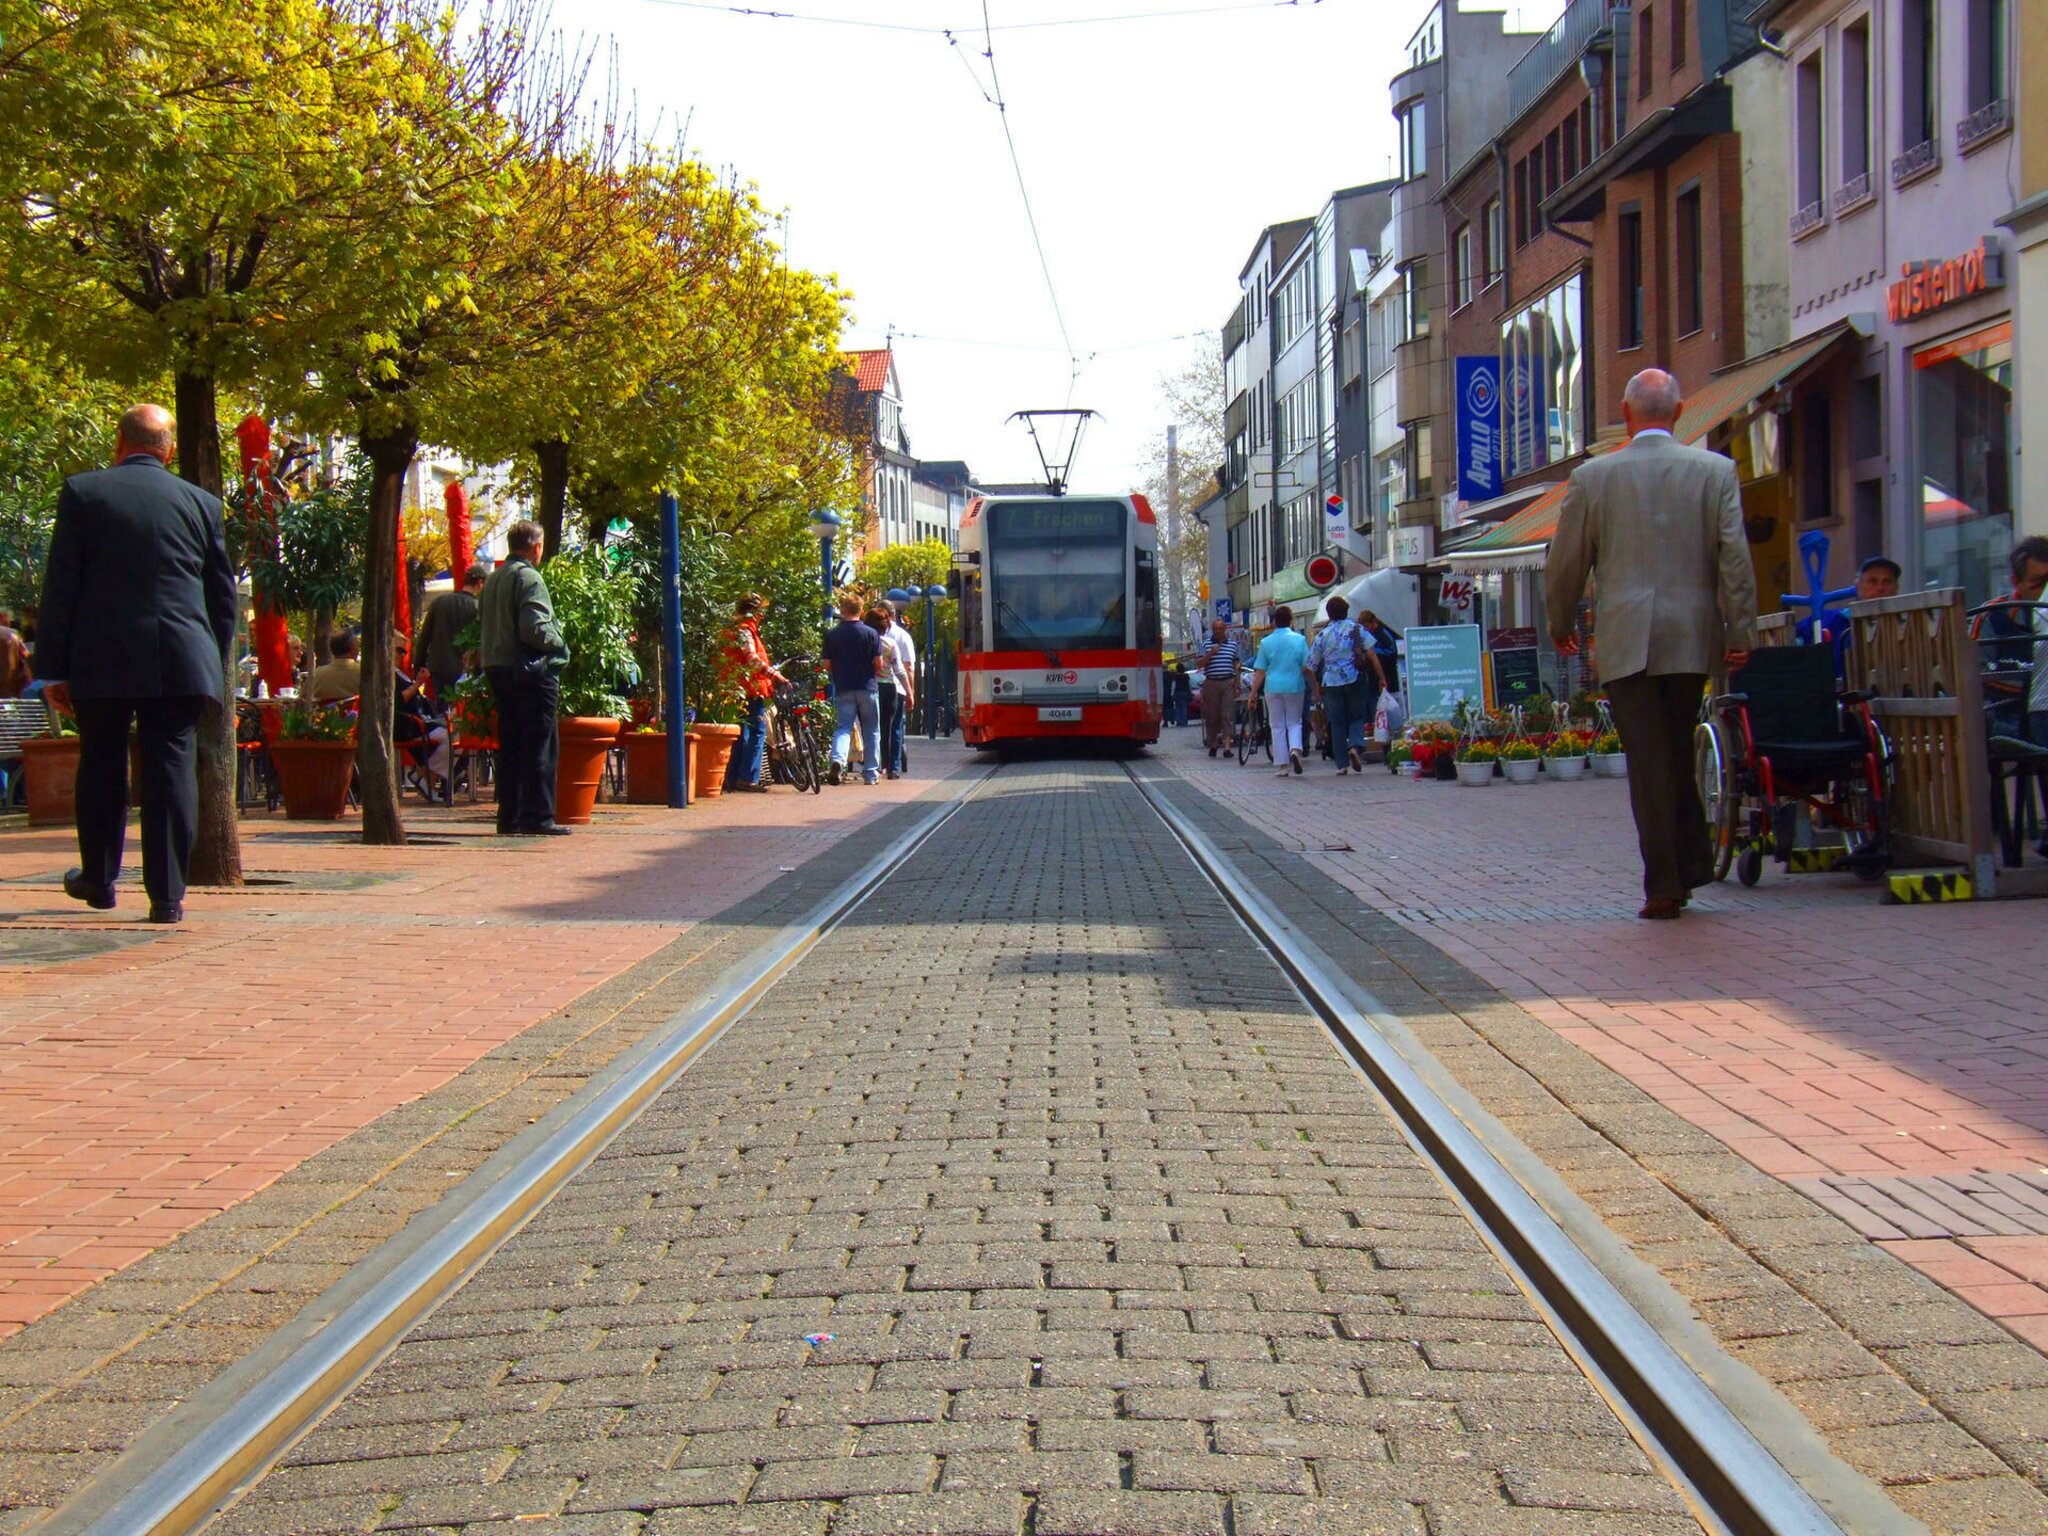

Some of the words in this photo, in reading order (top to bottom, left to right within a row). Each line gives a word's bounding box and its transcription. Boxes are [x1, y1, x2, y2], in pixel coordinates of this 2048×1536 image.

[1886, 235, 1988, 324] wüstenrot
[1466, 419, 1492, 490] APOLLO
[1490, 427, 1502, 461] OPTIK
[1045, 673, 1064, 683] KVB
[1048, 709, 1073, 719] 4044
